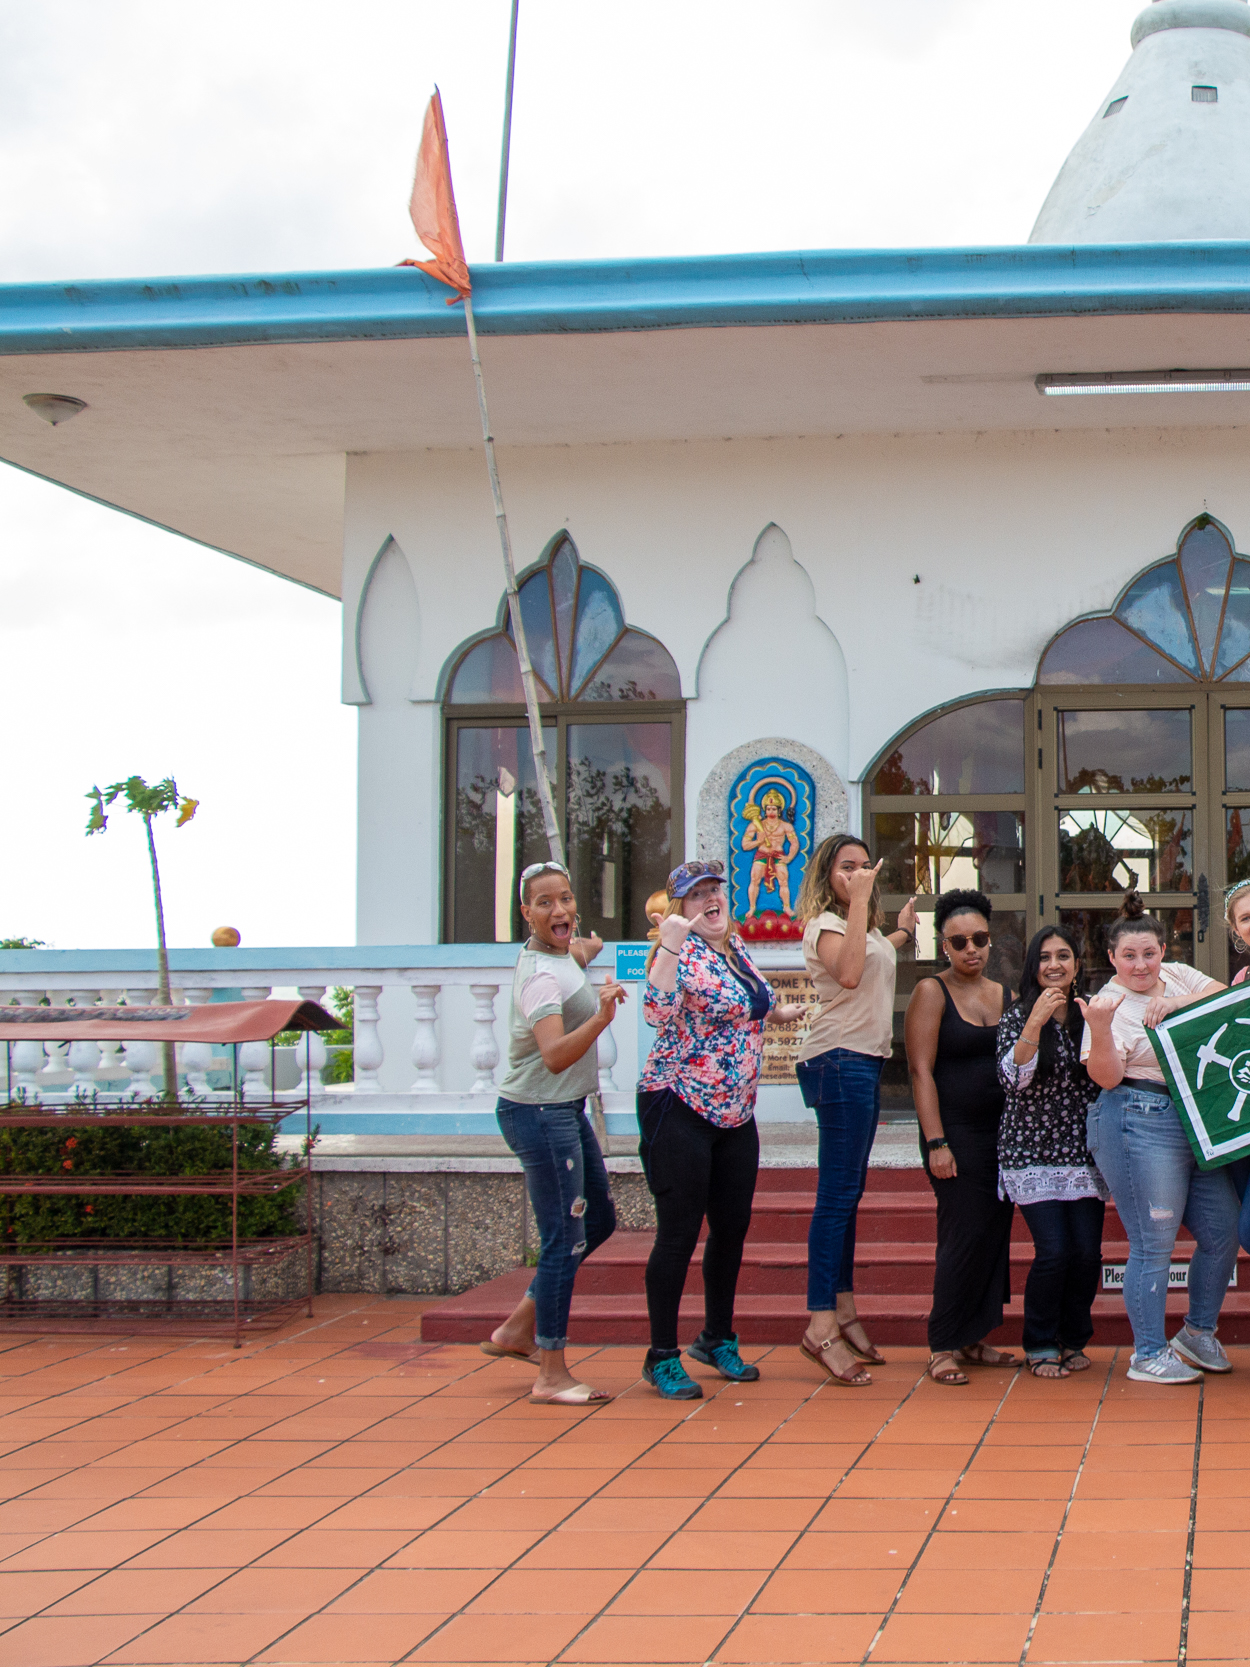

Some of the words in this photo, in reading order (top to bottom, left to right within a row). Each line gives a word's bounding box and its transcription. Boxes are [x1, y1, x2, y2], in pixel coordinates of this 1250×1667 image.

[617, 949, 649, 957] PLEASE
[627, 968, 646, 976] FOO
[767, 978, 799, 989] OME
[785, 994, 806, 1004] THE
[1168, 1270, 1187, 1283] our
